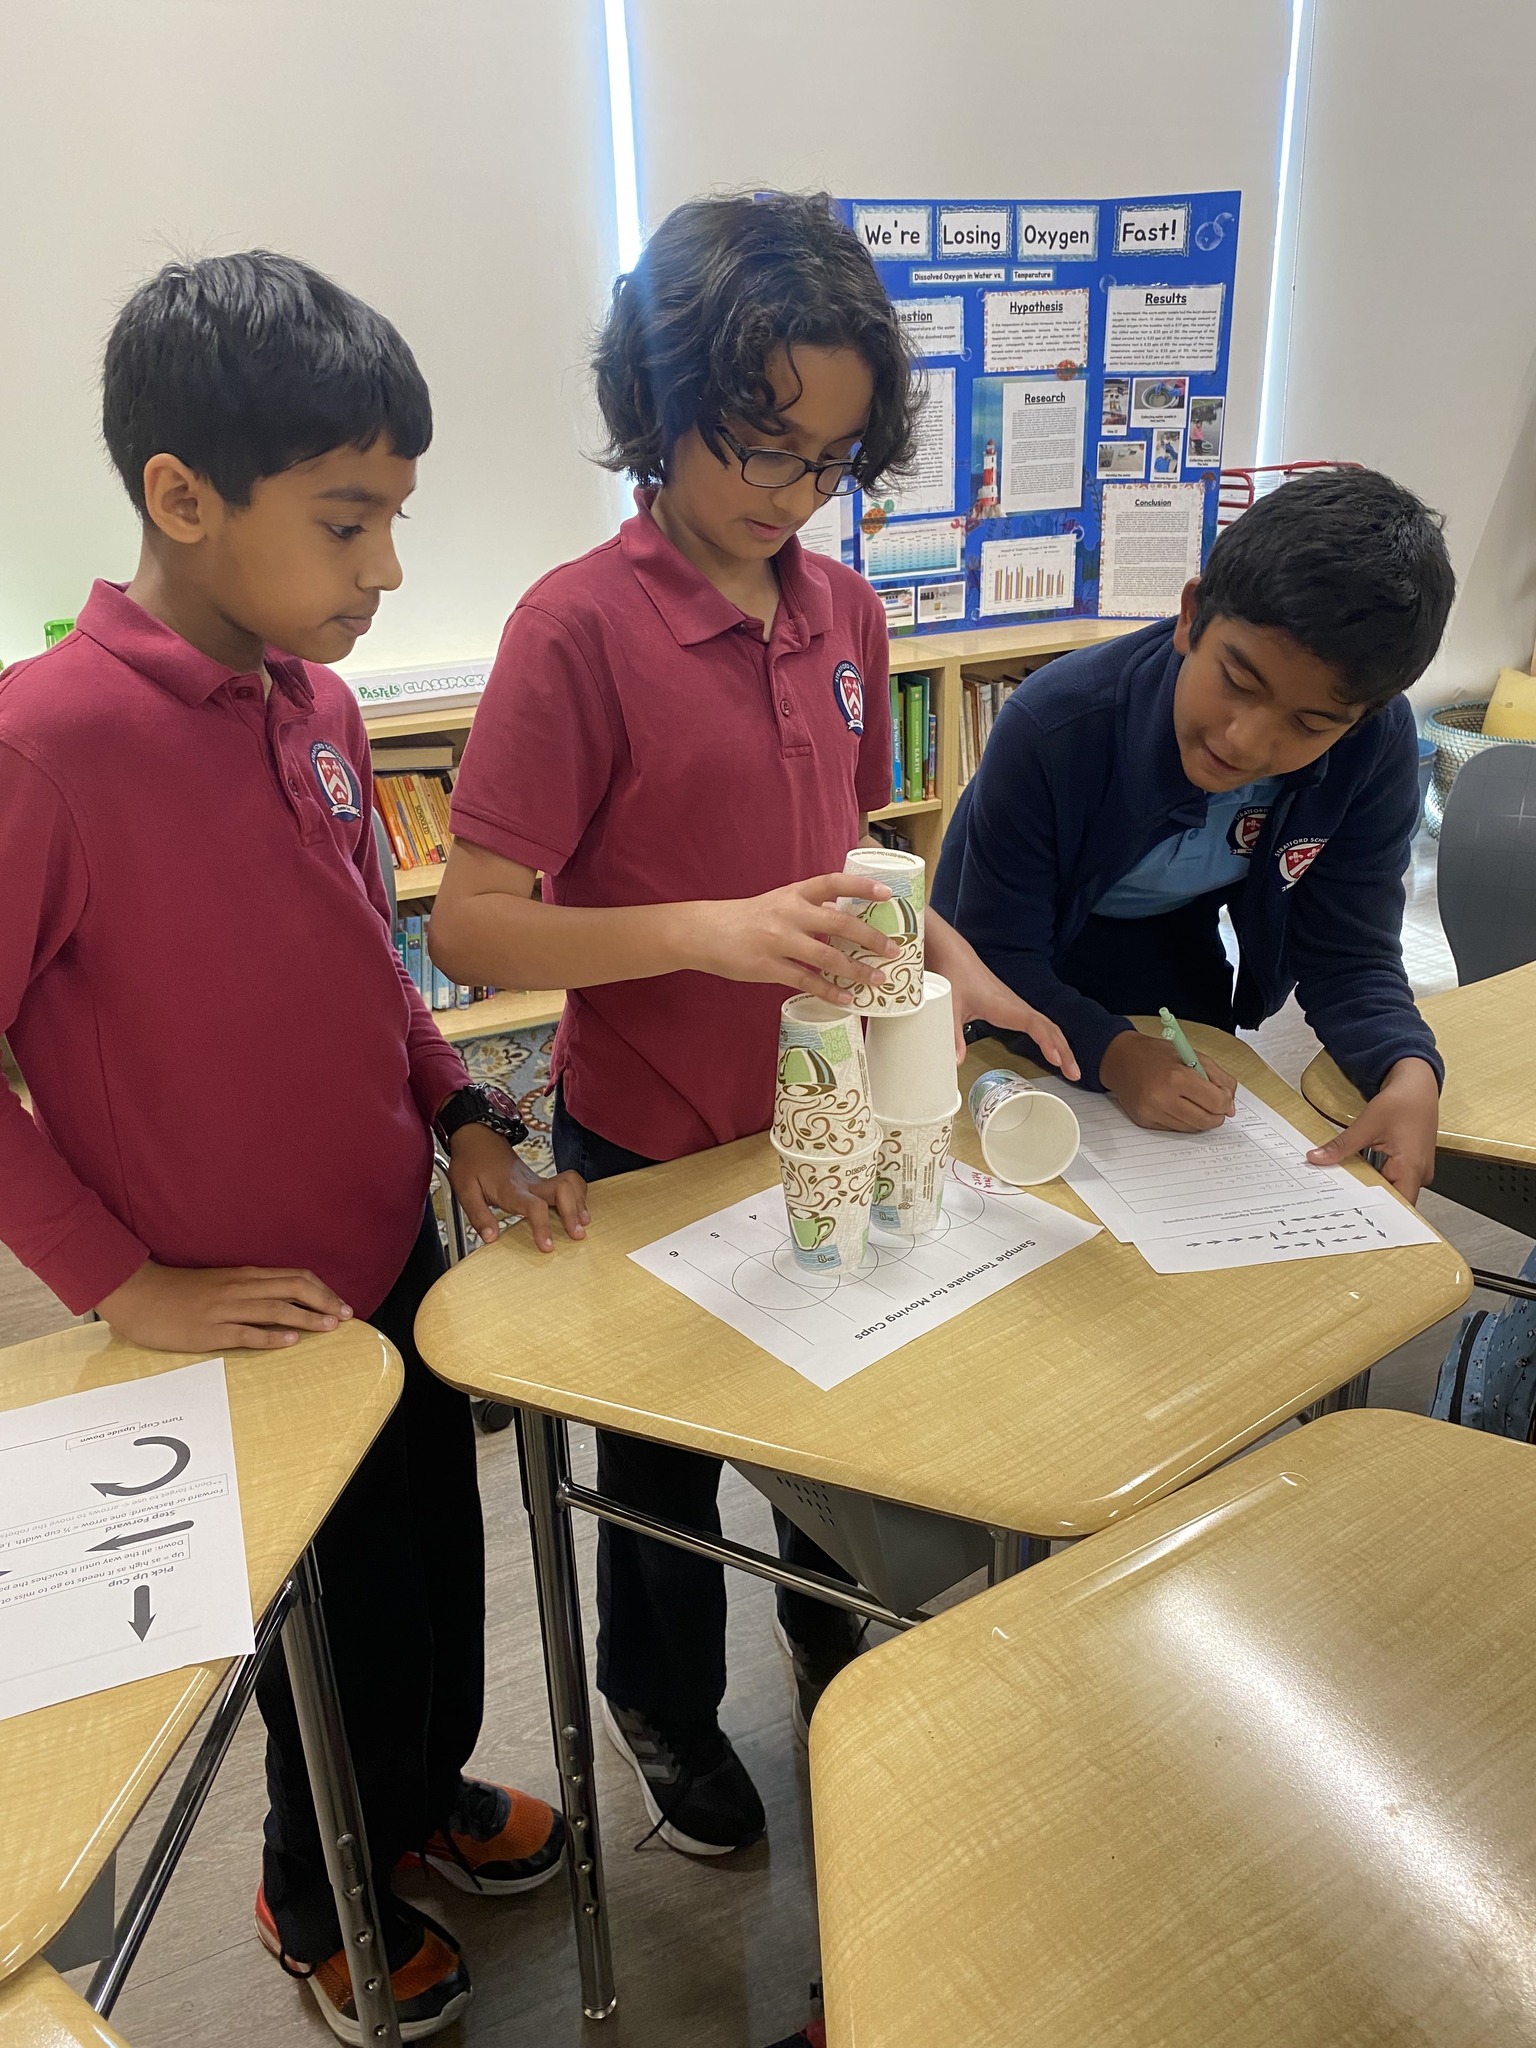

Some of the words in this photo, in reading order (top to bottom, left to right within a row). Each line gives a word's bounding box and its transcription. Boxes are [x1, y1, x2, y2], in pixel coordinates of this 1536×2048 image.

[865, 220, 920, 245] We're
[943, 225, 1000, 250] Losing
[1024, 225, 1089, 249] Oxygen
[1122, 219, 1177, 242] Fast!
[1014, 272, 1051, 280] Temperature
[1146, 293, 1187, 304] Results
[1010, 301, 1063, 315] Hypothesis
[1025, 392, 1066, 403] Research
[404, 674, 485, 694] CLASSPACK
[1235, 808, 1268, 820] STRATFORD
[1275, 838, 1308, 857] STRATFORD
[996, 1240, 1036, 1261] Sample
[946, 1261, 998, 1288] Template
[929, 1287, 948, 1298] for
[885, 1297, 930, 1322] Moving
[855, 1322, 886, 1340] Cups
[162, 1416, 184, 1424] Turn
[107, 1426, 135, 1436] Upside
[80, 1433, 105, 1443] Down
[161, 1488, 186, 1499] forget
[188, 1489, 224, 1501] Forward
[88, 1504, 118, 1515] arrows
[152, 1509, 175, 1519] Step
[49, 1516, 74, 1526] move
[80, 1518, 108, 1528] arrow
[104, 1516, 148, 1533] Forward
[32, 1523, 46, 1532] the
[155, 1540, 183, 1550] Down:
[79, 1561, 100, 1571] until
[129, 1560, 149, 1571] high
[151, 1566, 173, 1576] Pick
[31, 1570, 67, 1583] touches
[77, 1572, 106, 1584] needs
[50, 1582, 63, 1591] go
[108, 1578, 129, 1587] Cup
[14, 1591, 34, 1600] miss
